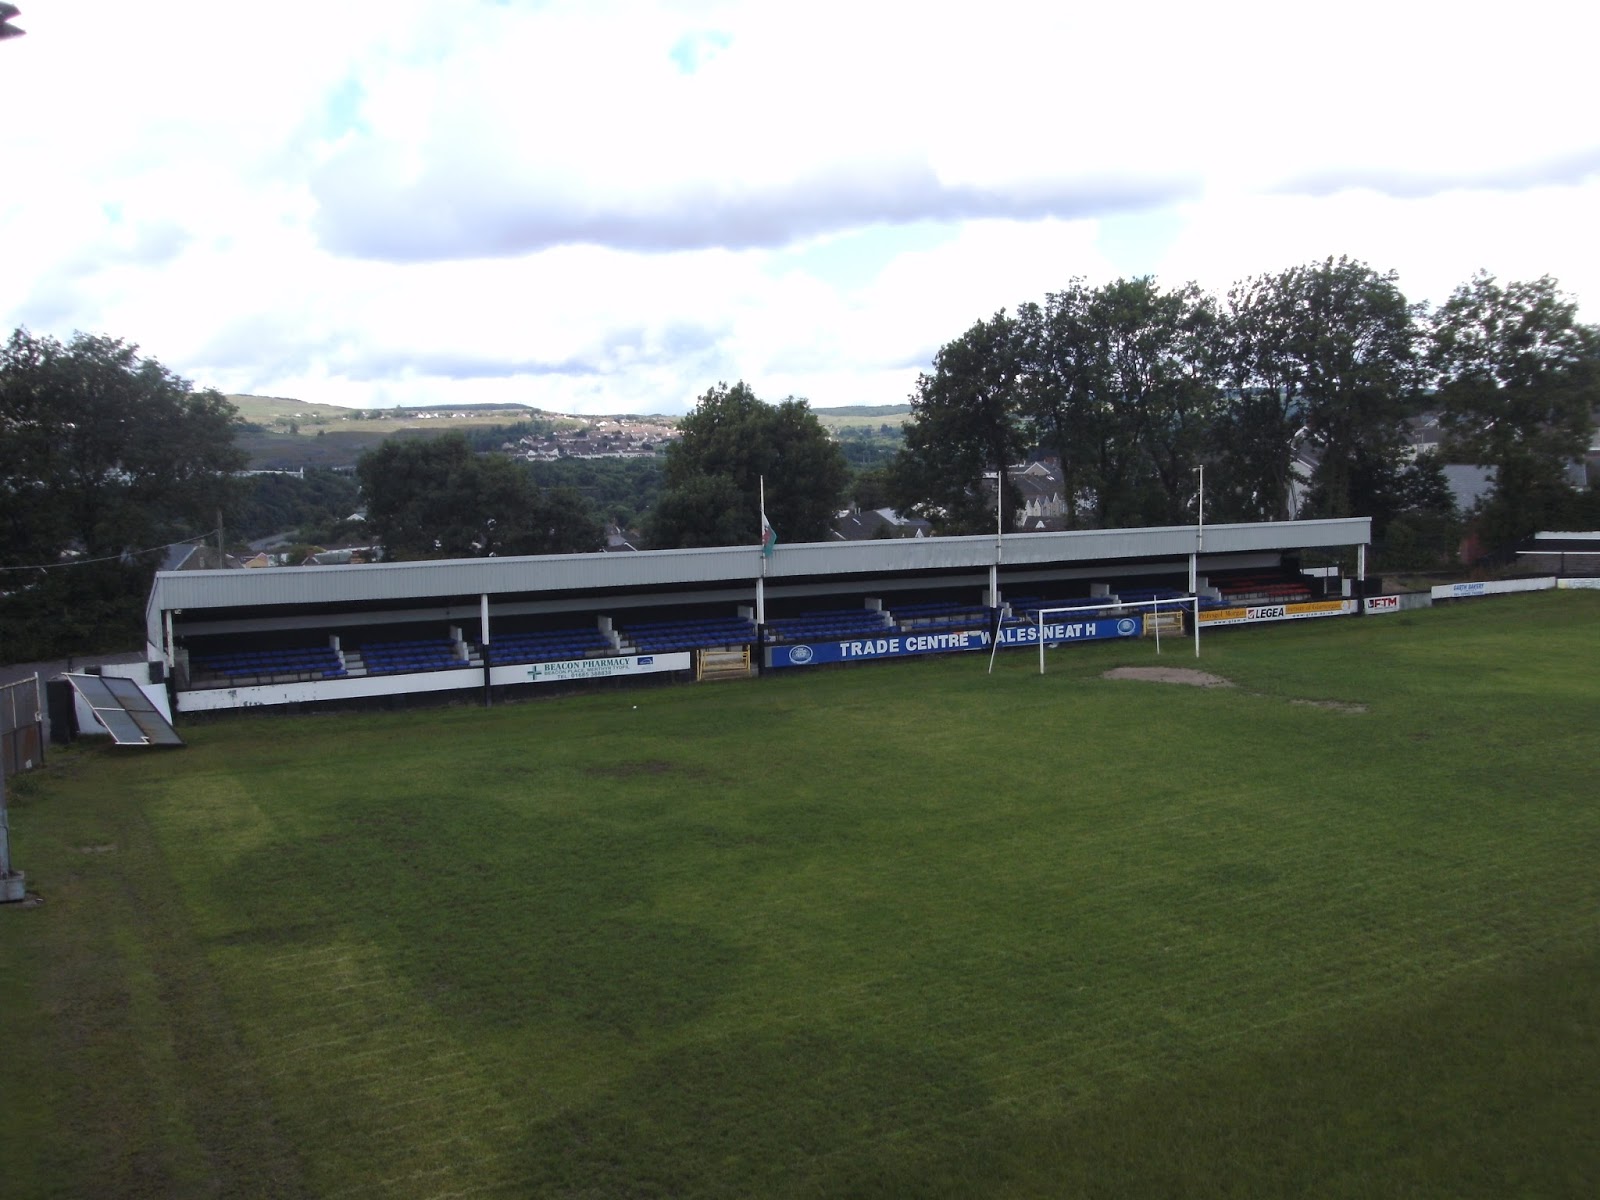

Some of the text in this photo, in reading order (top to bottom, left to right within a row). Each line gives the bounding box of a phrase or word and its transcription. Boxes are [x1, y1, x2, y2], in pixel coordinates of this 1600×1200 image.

[1255, 606, 1284, 619] LEGEA
[840, 638, 900, 657] TRADE
[905, 634, 969, 651] CENTRE
[544, 659, 630, 671] BEACON PHARMACY
